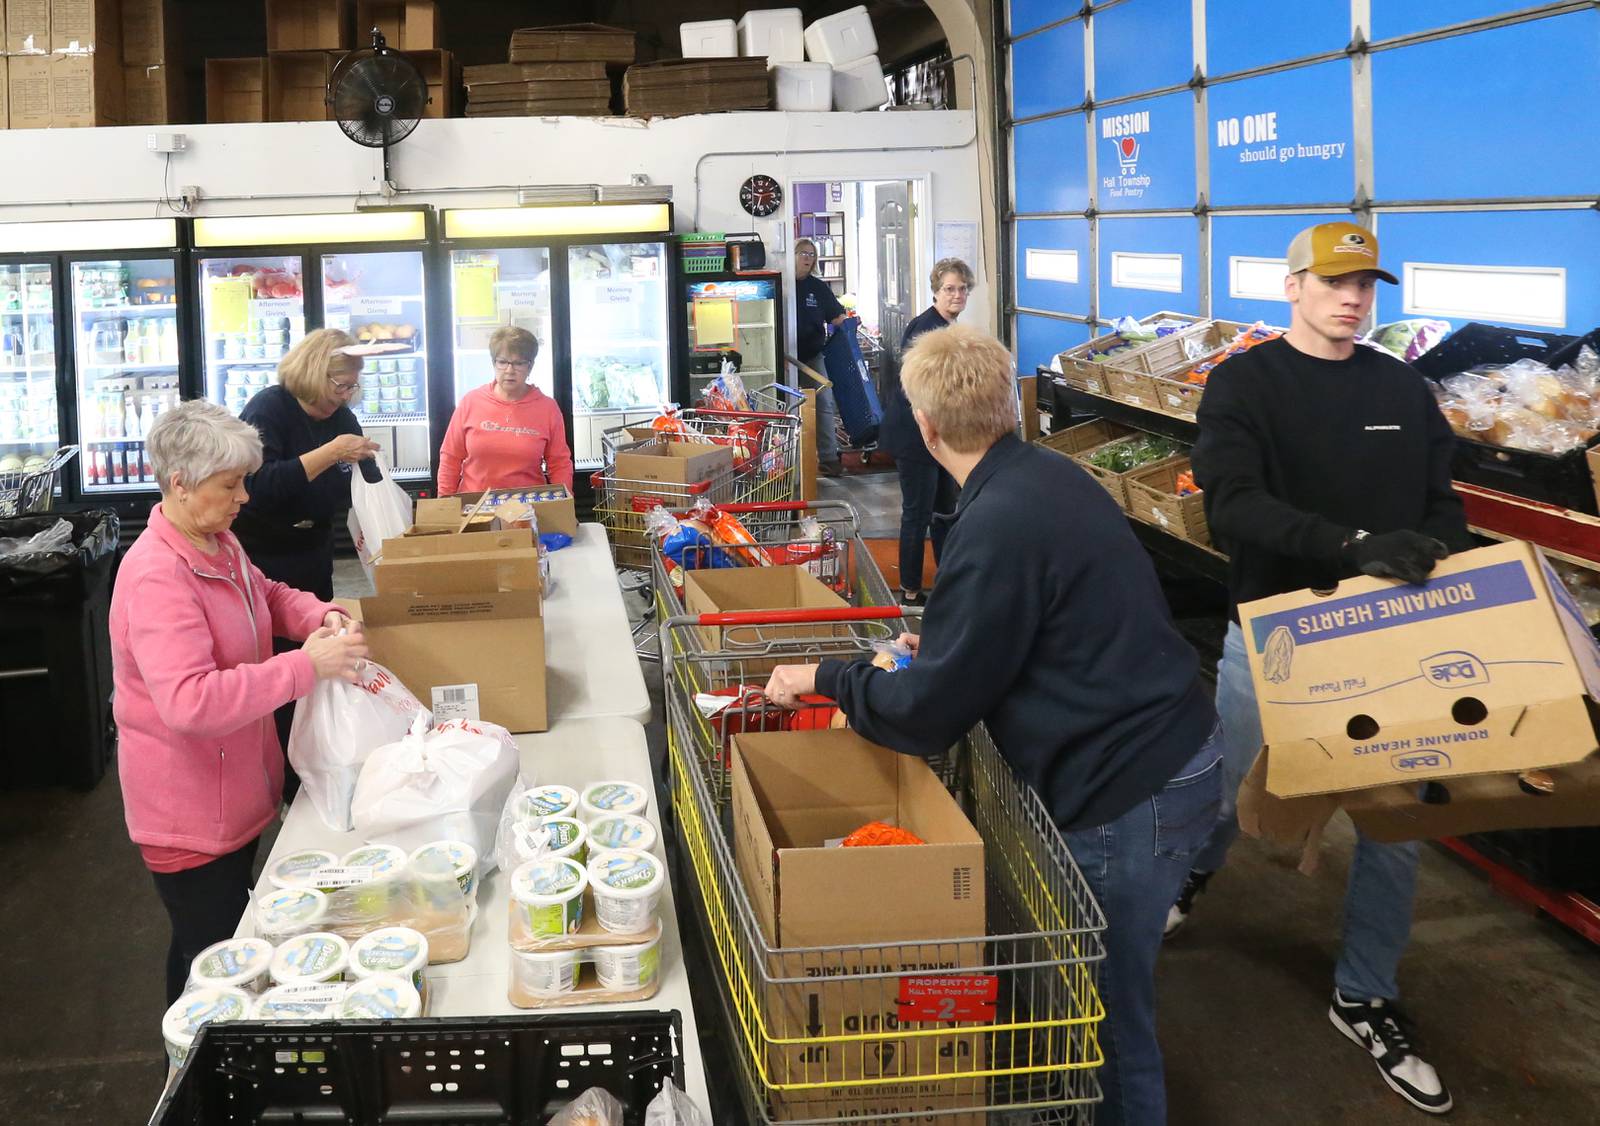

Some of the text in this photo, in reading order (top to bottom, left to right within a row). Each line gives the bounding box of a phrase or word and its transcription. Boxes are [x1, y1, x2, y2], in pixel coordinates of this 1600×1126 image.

[1102, 111, 1150, 138] MISSION
[1217, 112, 1278, 147] NO ONE
[1239, 142, 1346, 163] should go hungry
[1118, 174, 1151, 188] Township
[1110, 187, 1144, 199] Food Pantry
[1297, 582, 1477, 635] ROMAINE HEARTS
[1431, 660, 1477, 682] Dole
[1309, 676, 1367, 696] Field Packed
[1353, 729, 1489, 756] ROMAINE HEARTS
[1399, 756, 1441, 770] Dole
[908, 978, 989, 986] PROPERTY OF
[938, 997, 957, 1019] 2
[799, 1045, 830, 1063] UP
[939, 1040, 969, 1058] UP
